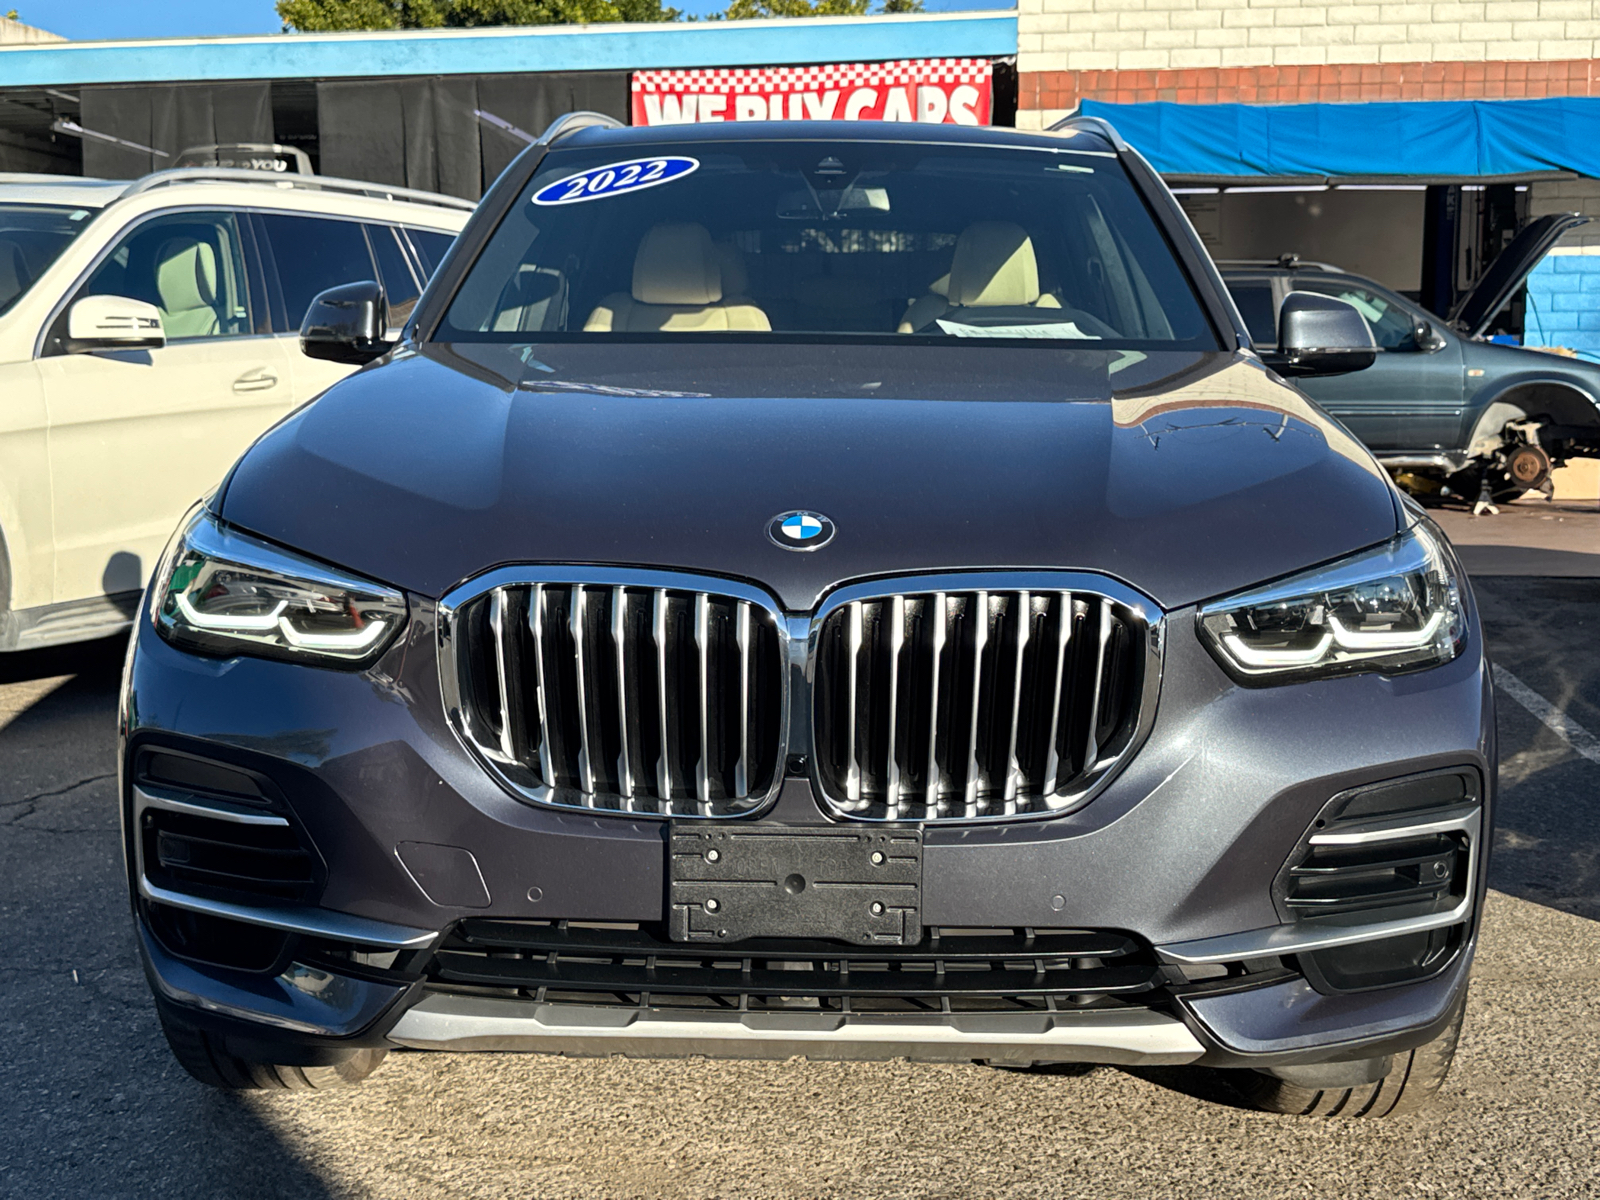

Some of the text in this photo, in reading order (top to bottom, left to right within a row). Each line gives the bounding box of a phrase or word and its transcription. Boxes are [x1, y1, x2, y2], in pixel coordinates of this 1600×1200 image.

[643, 93, 727, 127] WE
[251, 158, 287, 172] YOU
[558, 160, 668, 201] 2022
